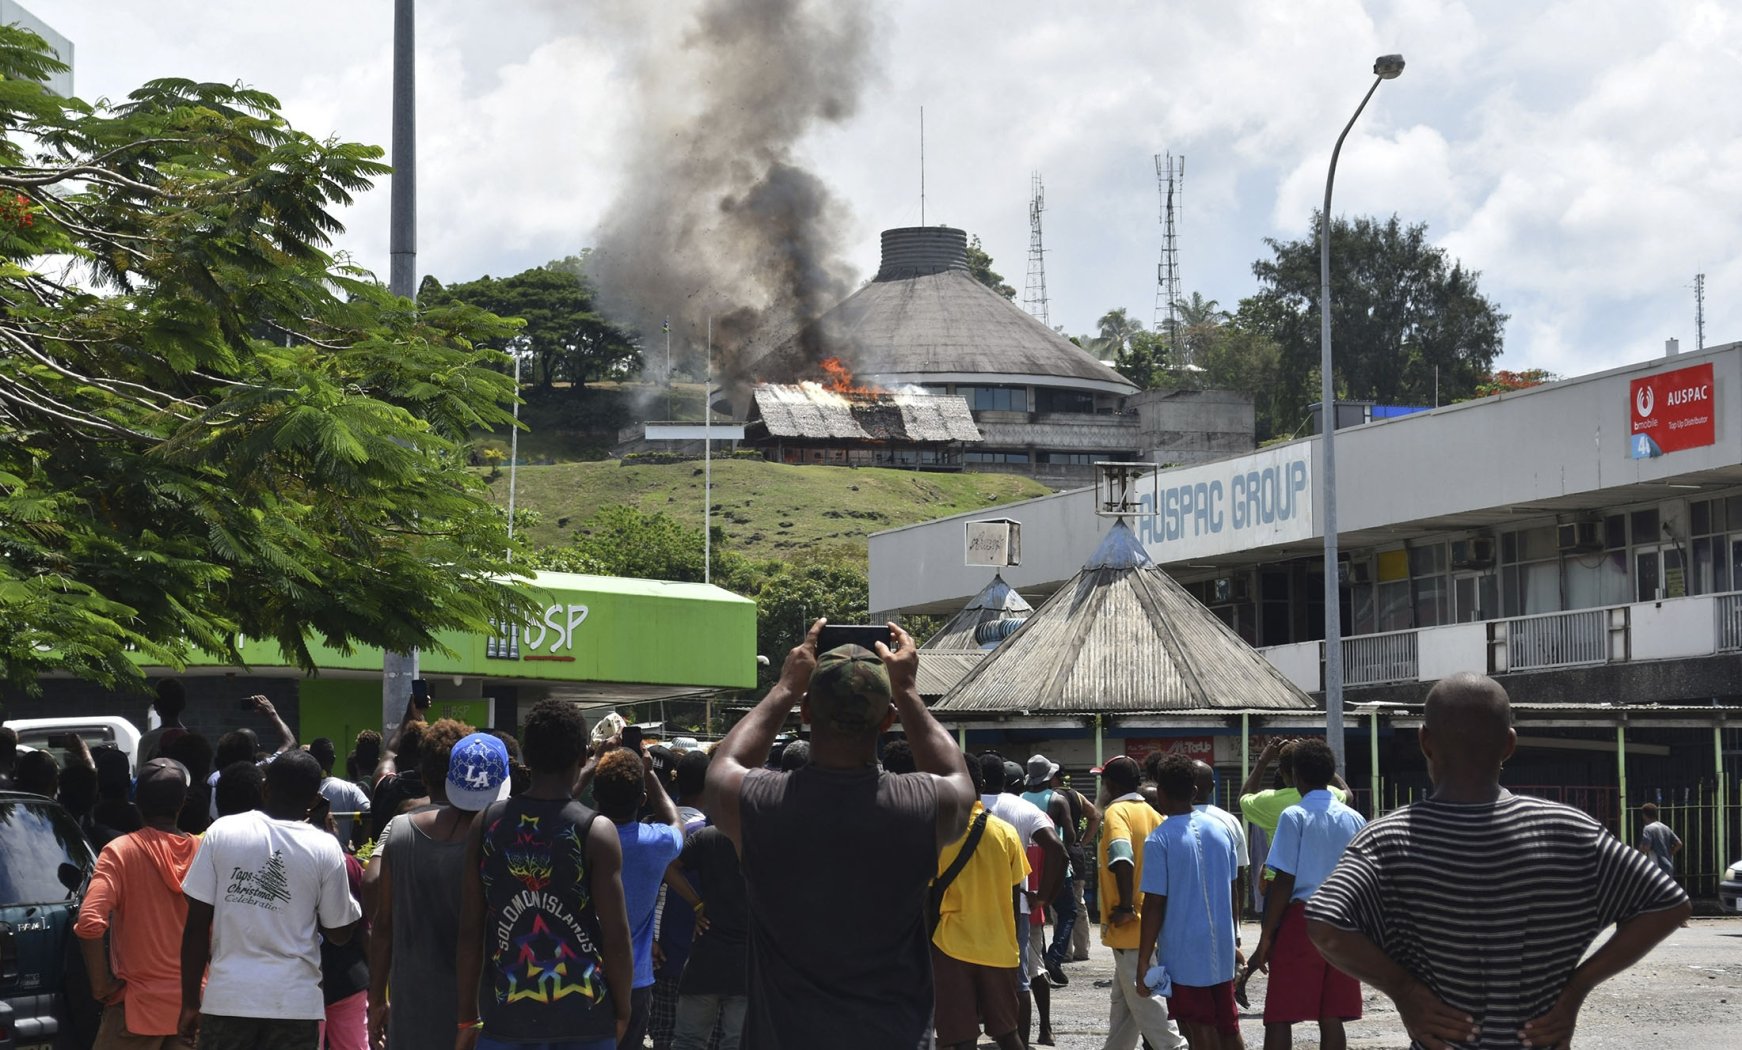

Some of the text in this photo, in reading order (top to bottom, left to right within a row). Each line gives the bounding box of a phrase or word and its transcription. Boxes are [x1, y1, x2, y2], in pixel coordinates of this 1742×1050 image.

[1667, 385, 1708, 406] AUSPAC
[1633, 418, 1659, 431] bmobile
[1684, 416, 1708, 427] Distributor
[1139, 460, 1307, 545] AUSPAC GROUP
[523, 603, 589, 653] BSP
[465, 765, 490, 788] LA
[226, 883, 277, 902] Christmas
